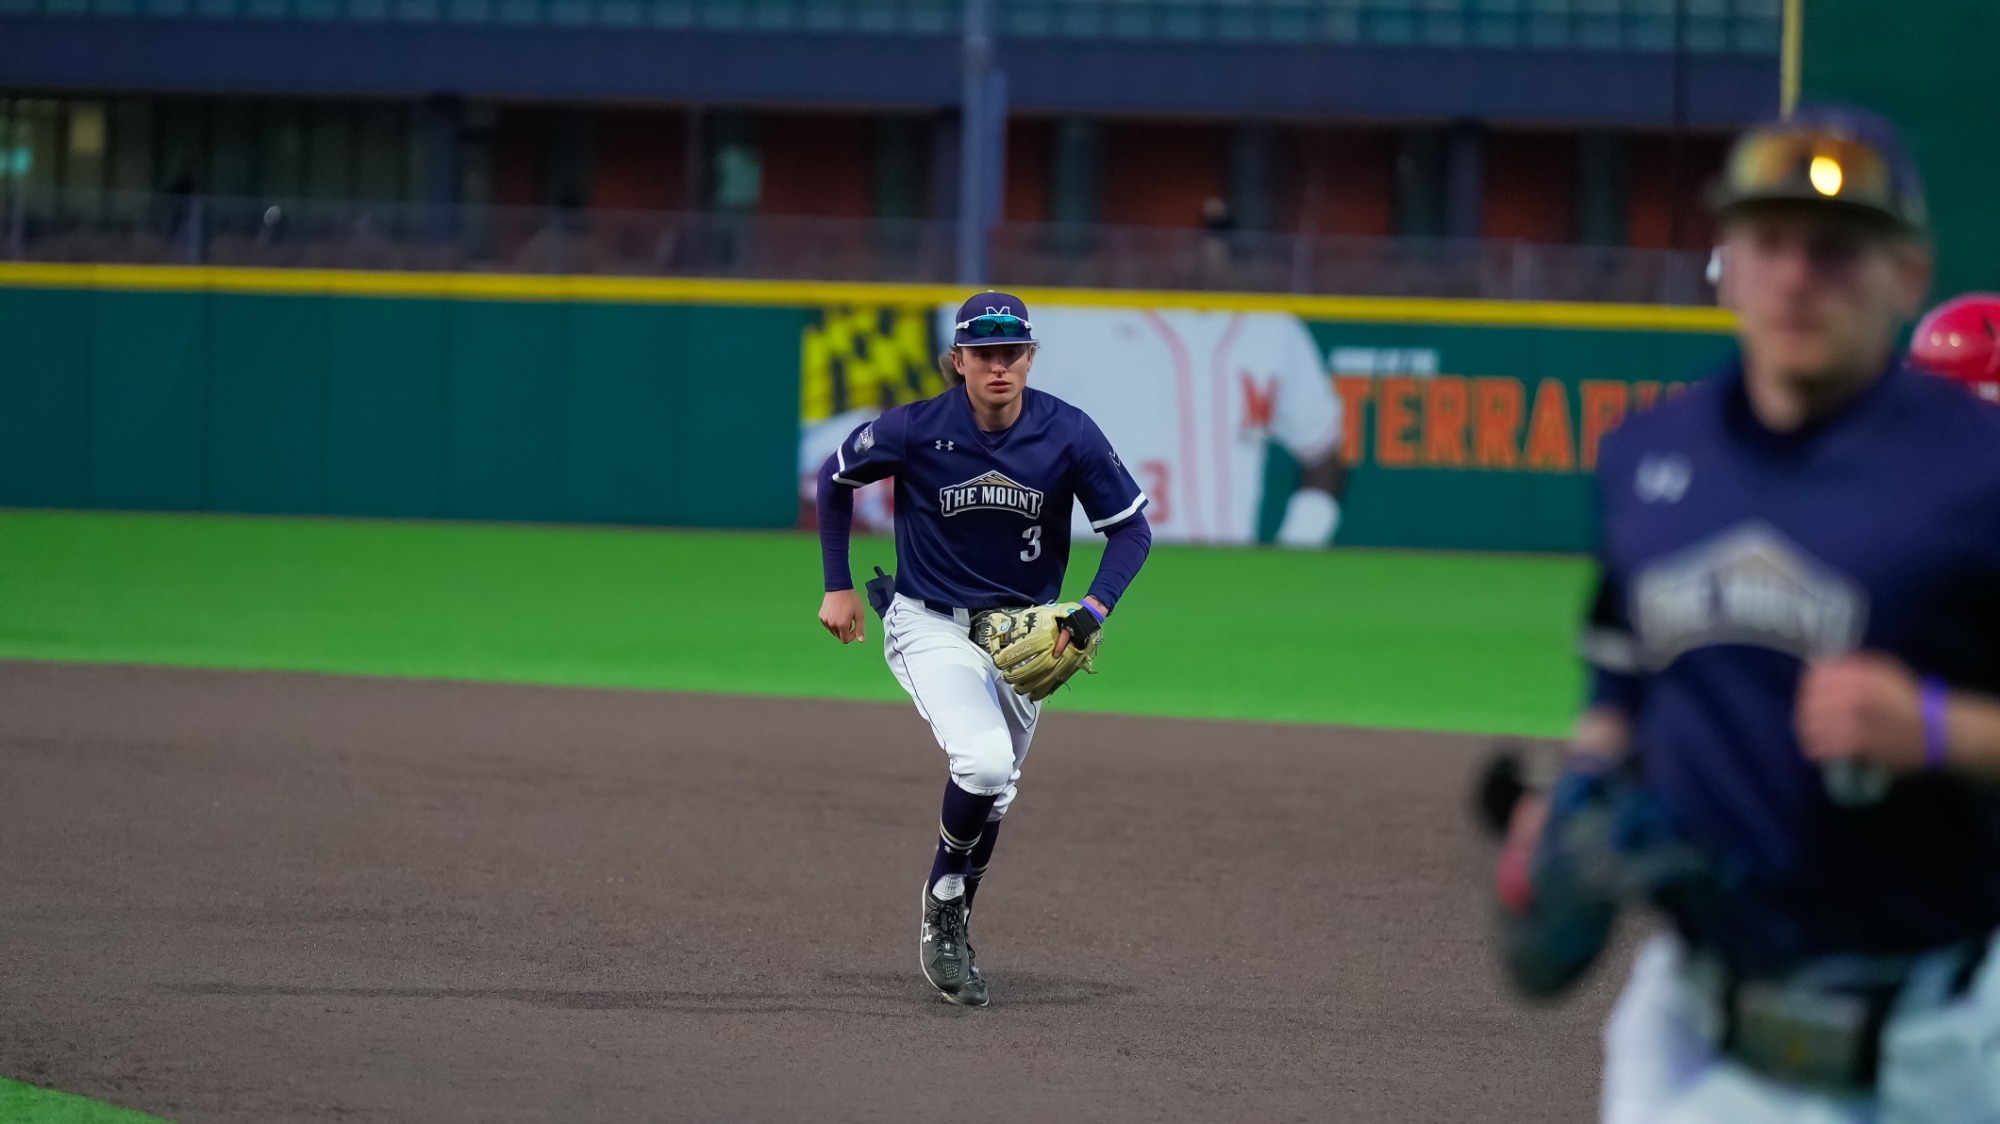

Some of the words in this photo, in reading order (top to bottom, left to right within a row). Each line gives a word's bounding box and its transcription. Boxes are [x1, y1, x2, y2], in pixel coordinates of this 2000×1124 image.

[1333, 374, 1708, 474] TERRAP
[943, 487, 977, 512] THE
[981, 486, 1040, 515] MOUNT
[1020, 525, 1042, 562] 3
